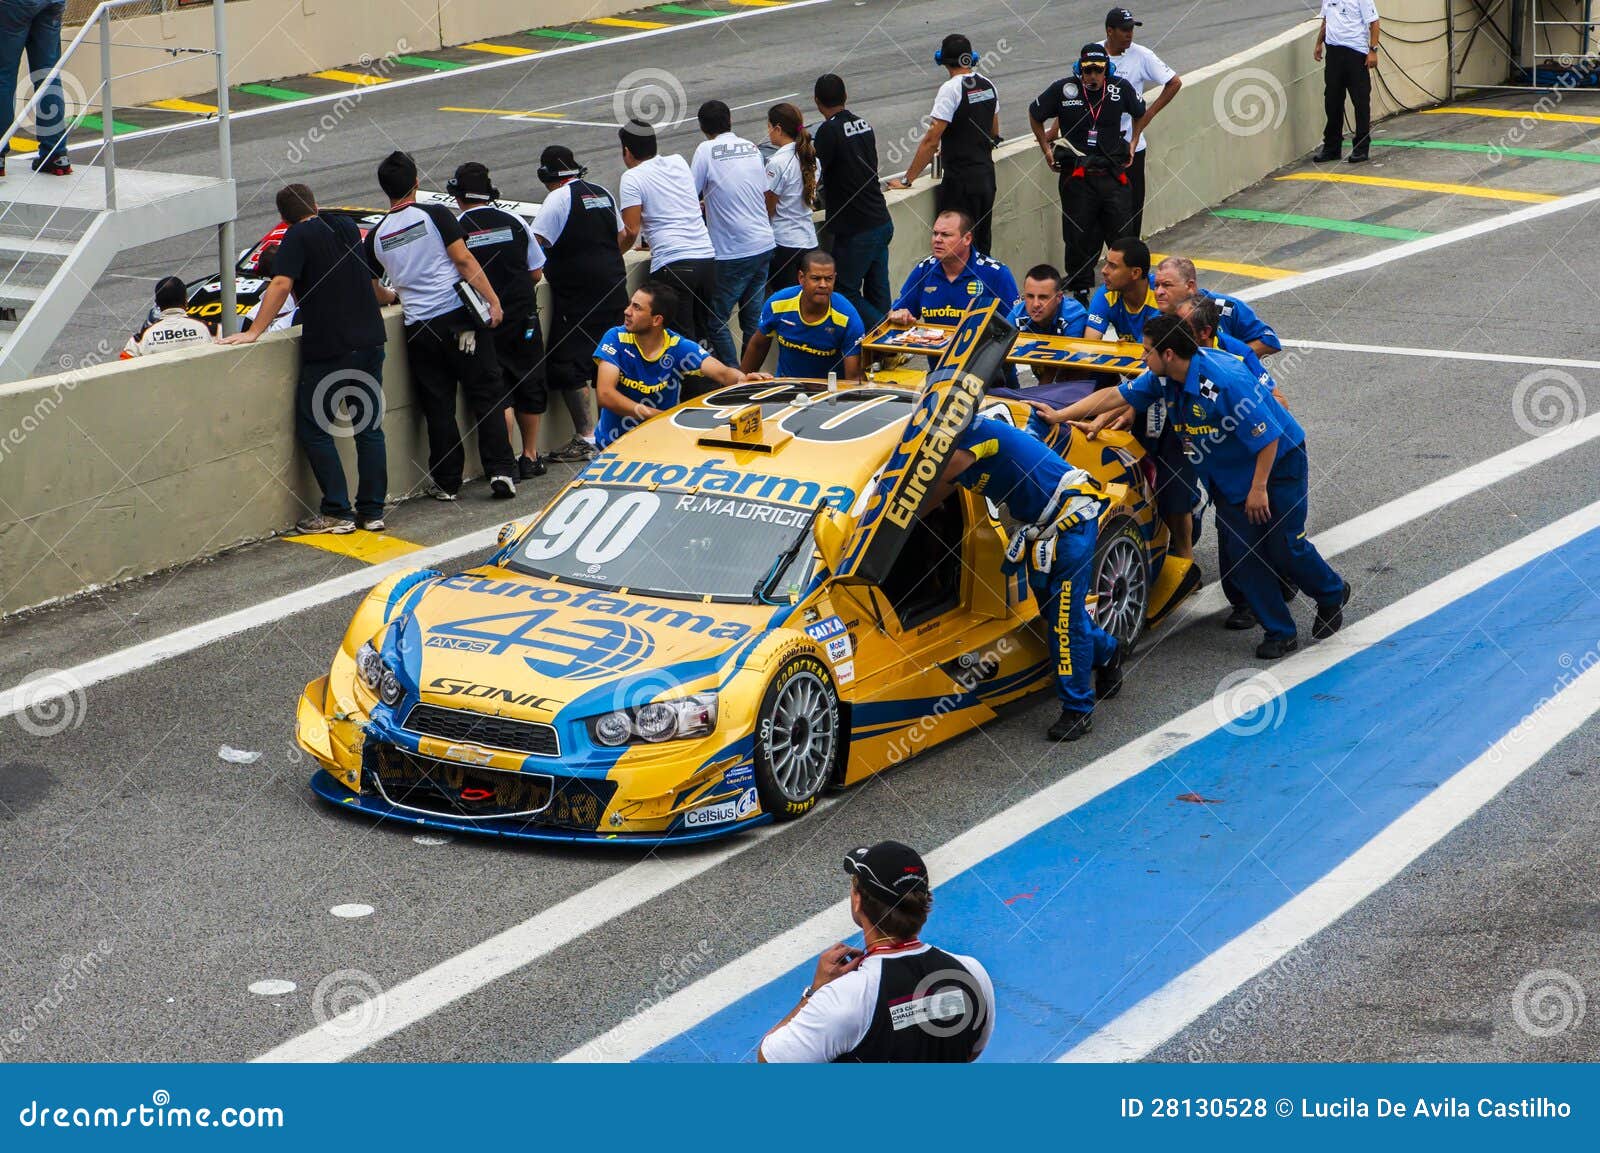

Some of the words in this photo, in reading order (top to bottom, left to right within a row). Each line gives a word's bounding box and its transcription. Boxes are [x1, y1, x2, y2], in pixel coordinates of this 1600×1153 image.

[164, 327, 197, 340] Beta
[885, 372, 985, 530] Eurofarma
[582, 453, 856, 514] Eurofarma
[524, 488, 661, 565] 90
[441, 573, 752, 641] Eurofarma
[427, 636, 488, 653] ANOS
[808, 618, 845, 640] CAIXA
[829, 638, 846, 650] Mobil
[1054, 580, 1073, 676] Eurofarma
[831, 648, 847, 661] Super
[776, 657, 829, 692] GOODYEAR
[421, 677, 565, 712] SONIC
[686, 808, 735, 825] Celsius
